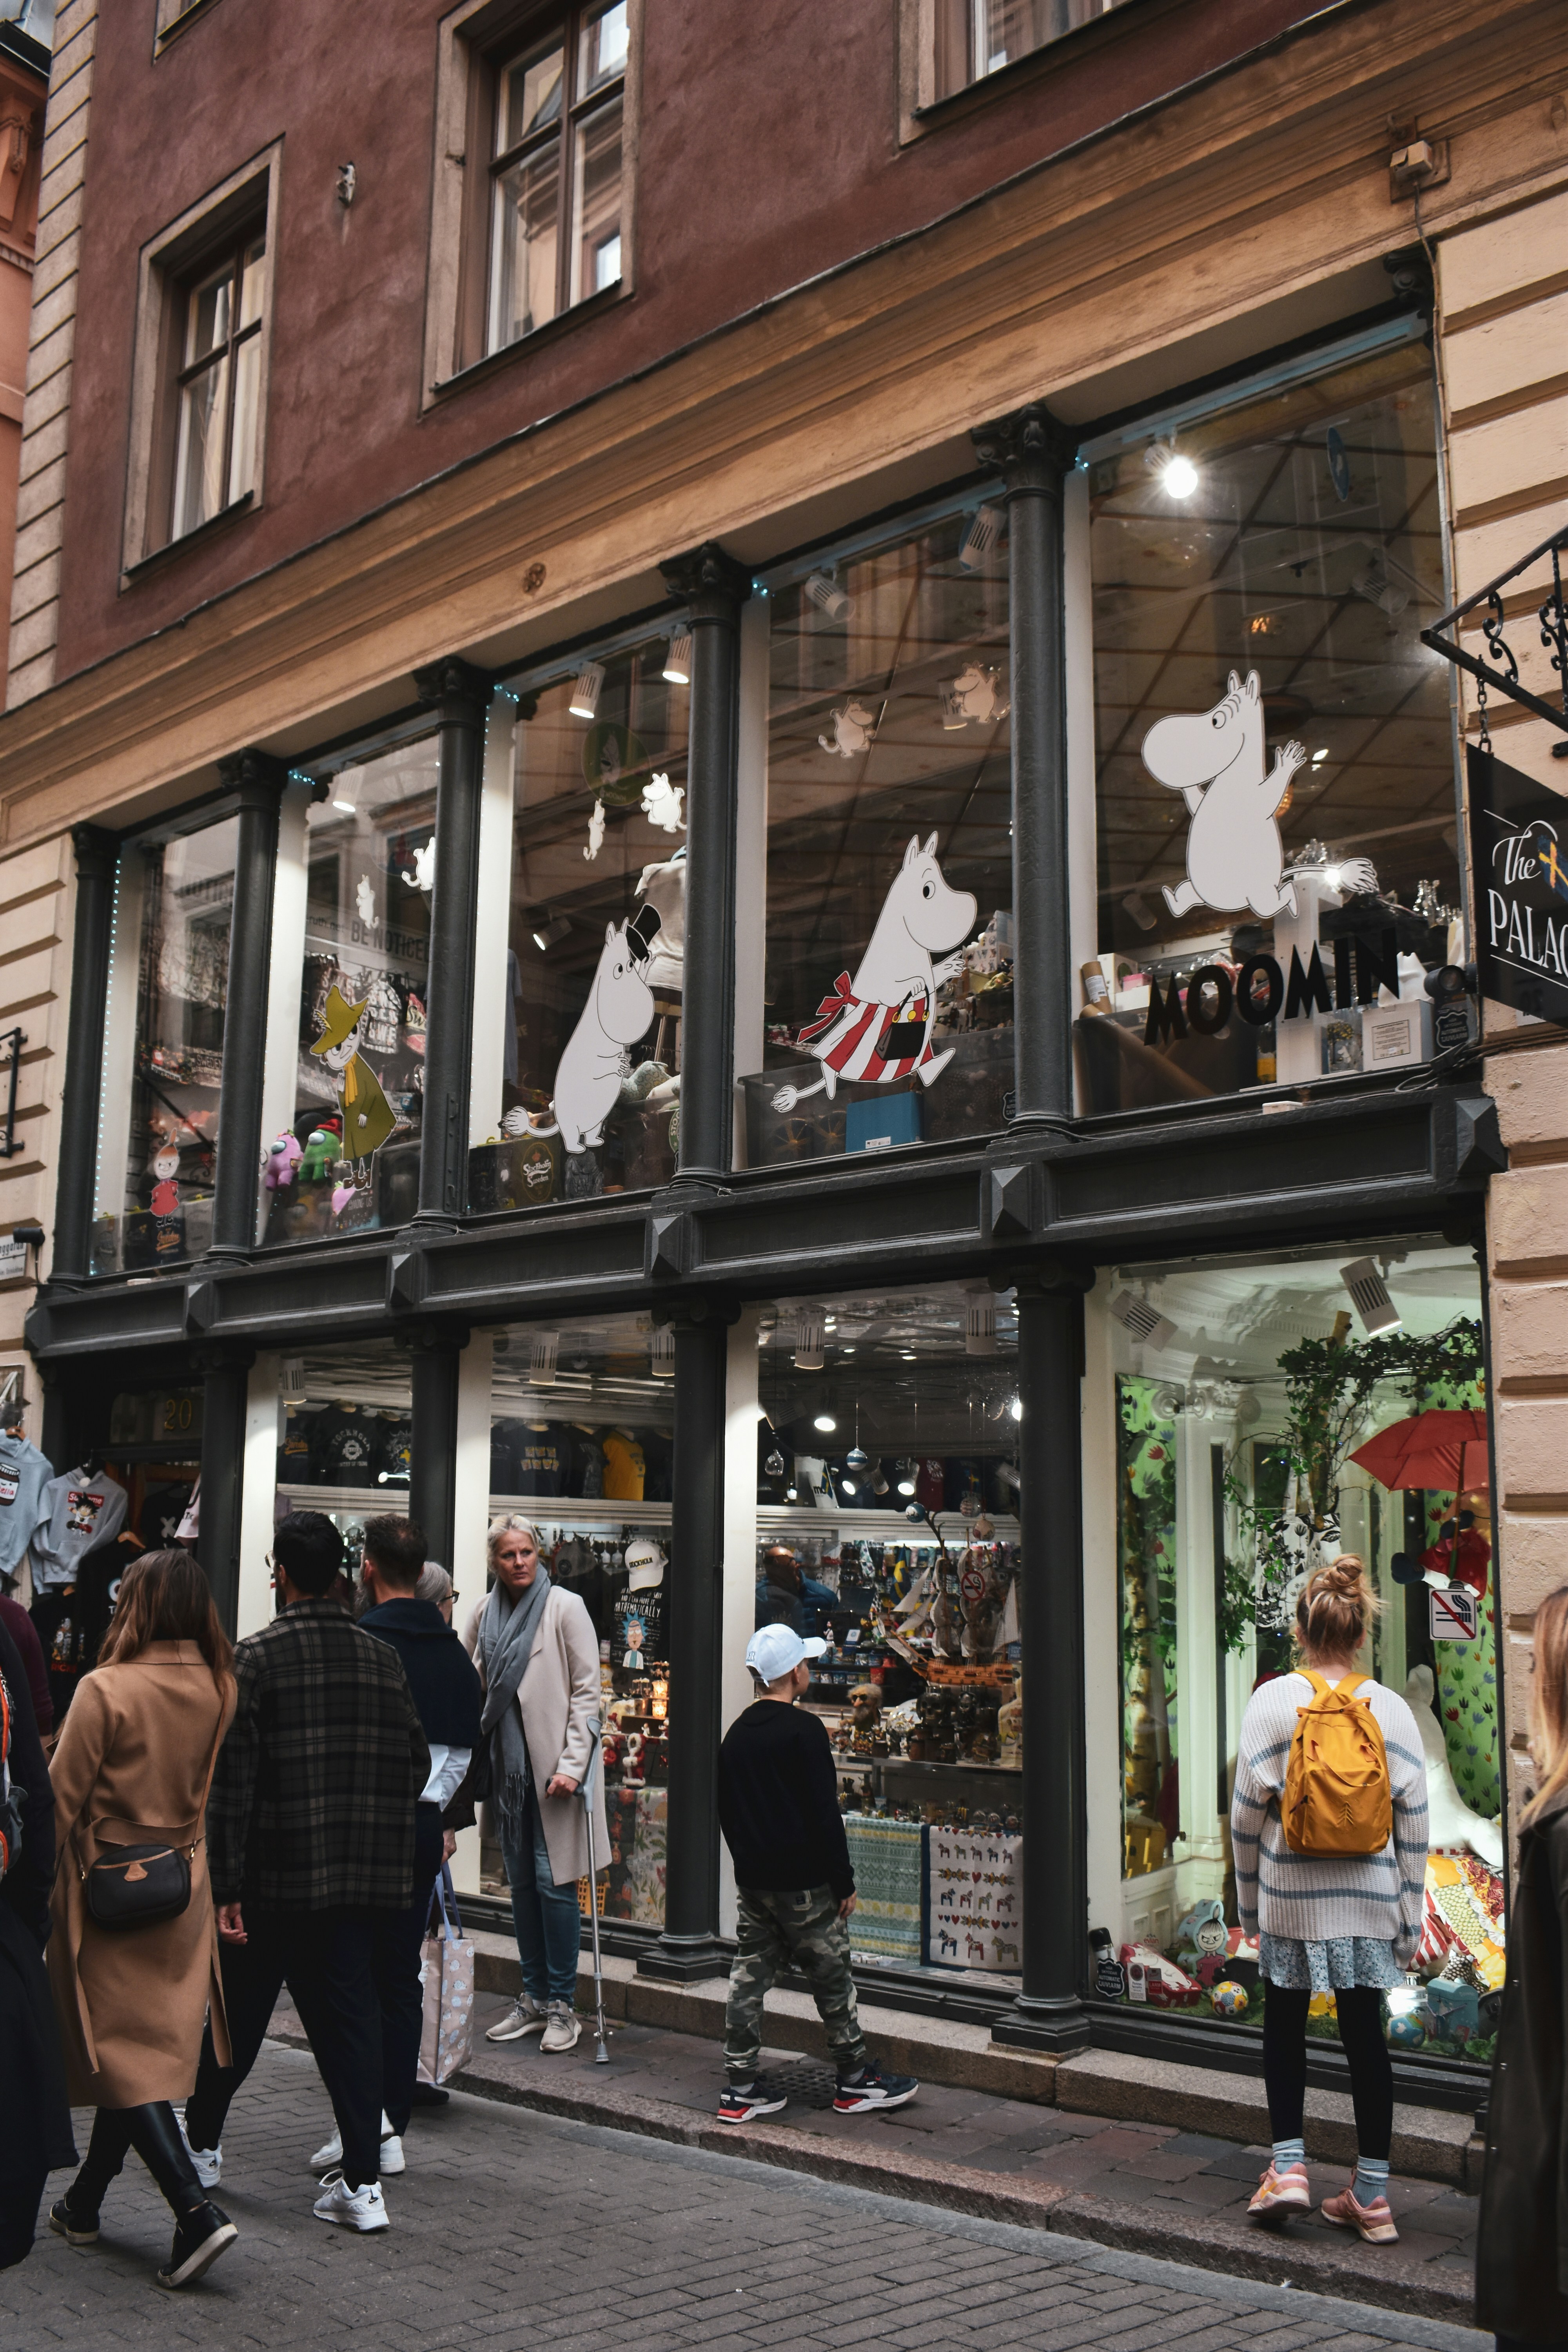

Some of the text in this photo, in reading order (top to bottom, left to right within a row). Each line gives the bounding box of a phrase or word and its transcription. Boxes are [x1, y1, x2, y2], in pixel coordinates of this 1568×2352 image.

[1492, 820, 1558, 885] The
[1143, 927, 1399, 1046] MOOMIN
[523, 1159, 551, 1176] Stockholm
[527, 1174, 549, 1187] Sweden
[0, 1242, 24, 1257] ggatan
[164, 1399, 191, 1430] 20
[69, 1493, 102, 1504] Sume
[614, 1601, 661, 1618] MATHEMATICALLY
[1098, 1981, 1121, 1989] TJUVLARM
